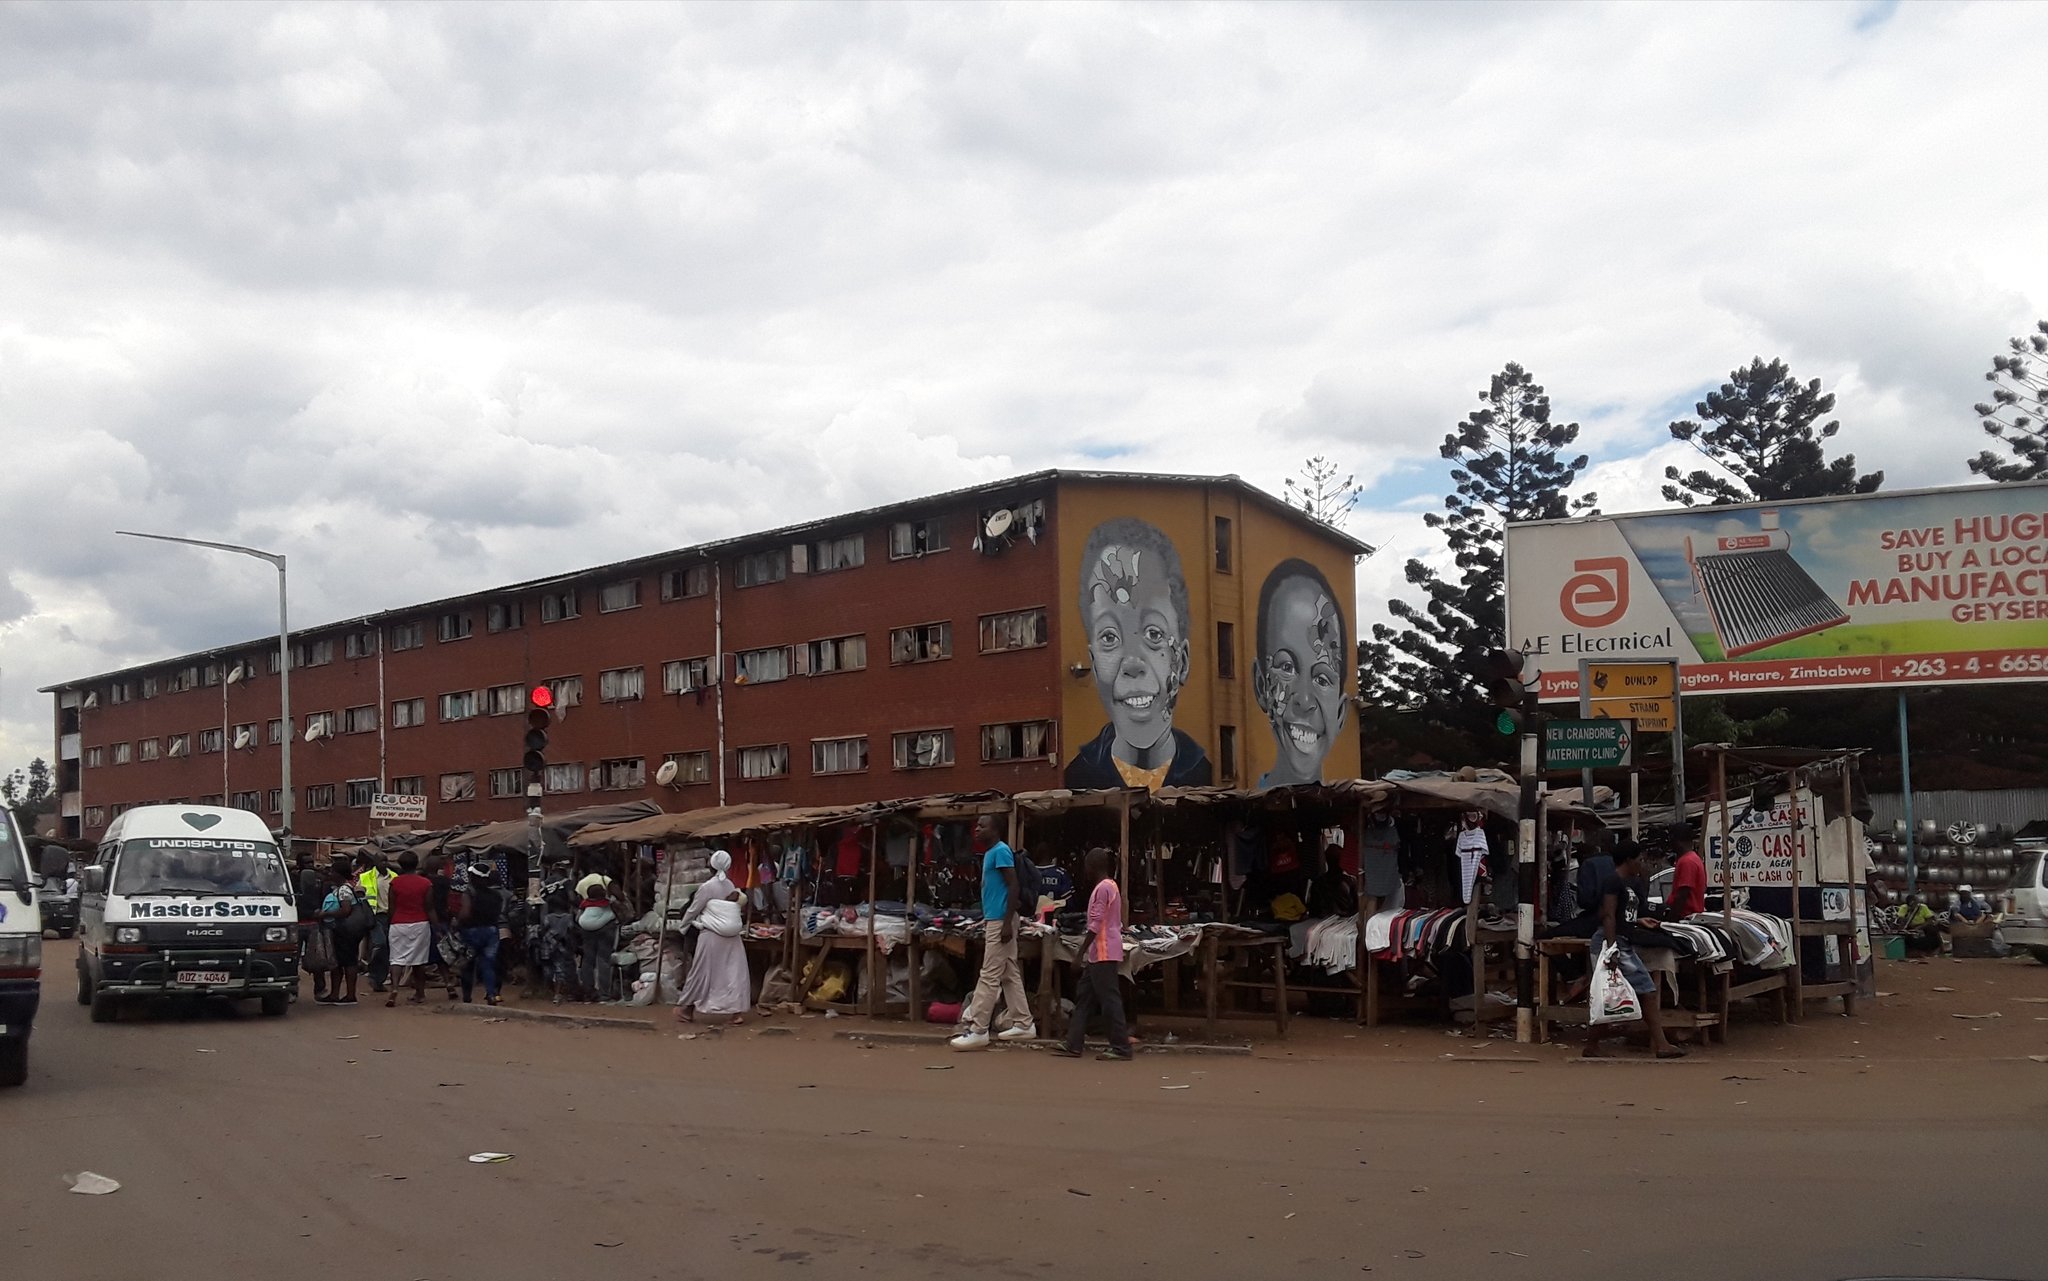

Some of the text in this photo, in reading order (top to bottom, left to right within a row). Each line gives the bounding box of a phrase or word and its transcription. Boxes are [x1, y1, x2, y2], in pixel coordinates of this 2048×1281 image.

[1881, 527, 1945, 550] SAVE
[1898, 545, 2048, 572] BUY A LOC
[1951, 600, 2048, 623] GEYSER
[1546, 679, 1579, 693] Lytto
[1680, 671, 1725, 687] ngton,
[1728, 670, 1785, 683] Harare,
[1789, 664, 1871, 680] Zimbabwe
[1891, 658, 1947, 677] +263
[1965, 657, 1981, 673] 4
[1625, 676, 1658, 686] DUNLOP
[1629, 702, 1659, 713] STRAND
[1546, 727, 1616, 740] NEW CRANBORNE
[1546, 747, 1617, 760] MATERNITY CLINIC
[399, 796, 425, 806] CASH
[150, 839, 256, 850] UNDISPUTED
[1714, 858, 1792, 870] REISTERED AGEN
[1713, 872, 1735, 884] CAH
[1739, 871, 1748, 883] IN
[1758, 870, 1782, 882] CASH
[1786, 870, 1803, 881] OT
[130, 901, 282, 919] MasterSaver
[179, 972, 226, 982] ADZ 4046
